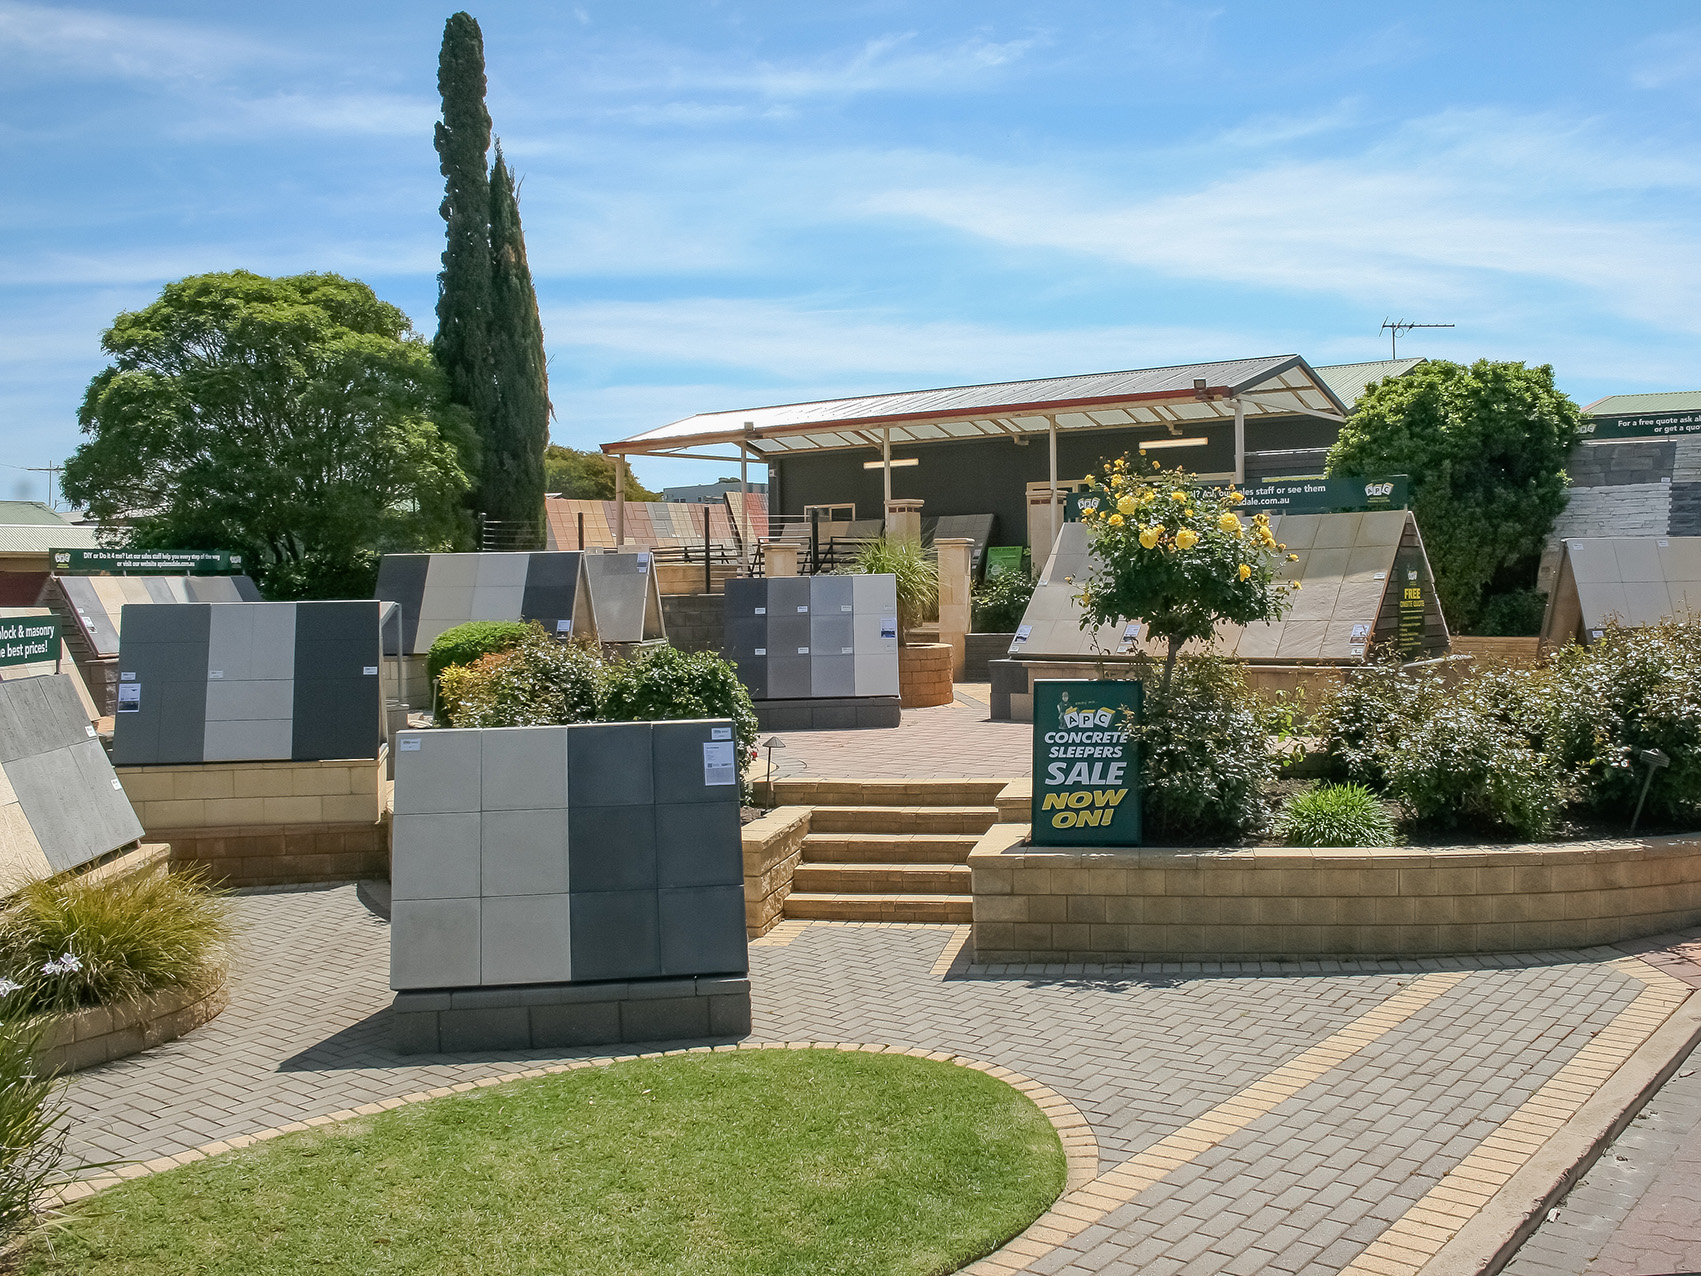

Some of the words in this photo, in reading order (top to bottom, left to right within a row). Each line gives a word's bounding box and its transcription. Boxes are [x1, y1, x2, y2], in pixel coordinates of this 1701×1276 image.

[1656, 418, 1678, 426] quote
[1256, 486, 1274, 496] staff
[1304, 485, 1326, 493] them
[1241, 496, 1290, 506] dale.com.au
[1404, 588, 1420, 599] FREE
[0, 625, 16, 640] lock
[18, 625, 24, 638] &
[26, 626, 54, 639] masonry
[7, 643, 23, 657] best
[25, 640, 48, 659] prices!
[1044, 732, 1129, 743] CONCRETE
[1049, 746, 1123, 758] SLEEPERS
[1045, 762, 1127, 785] SALE
[1042, 788, 1128, 810] NOW
[1052, 808, 1114, 828] ON!
